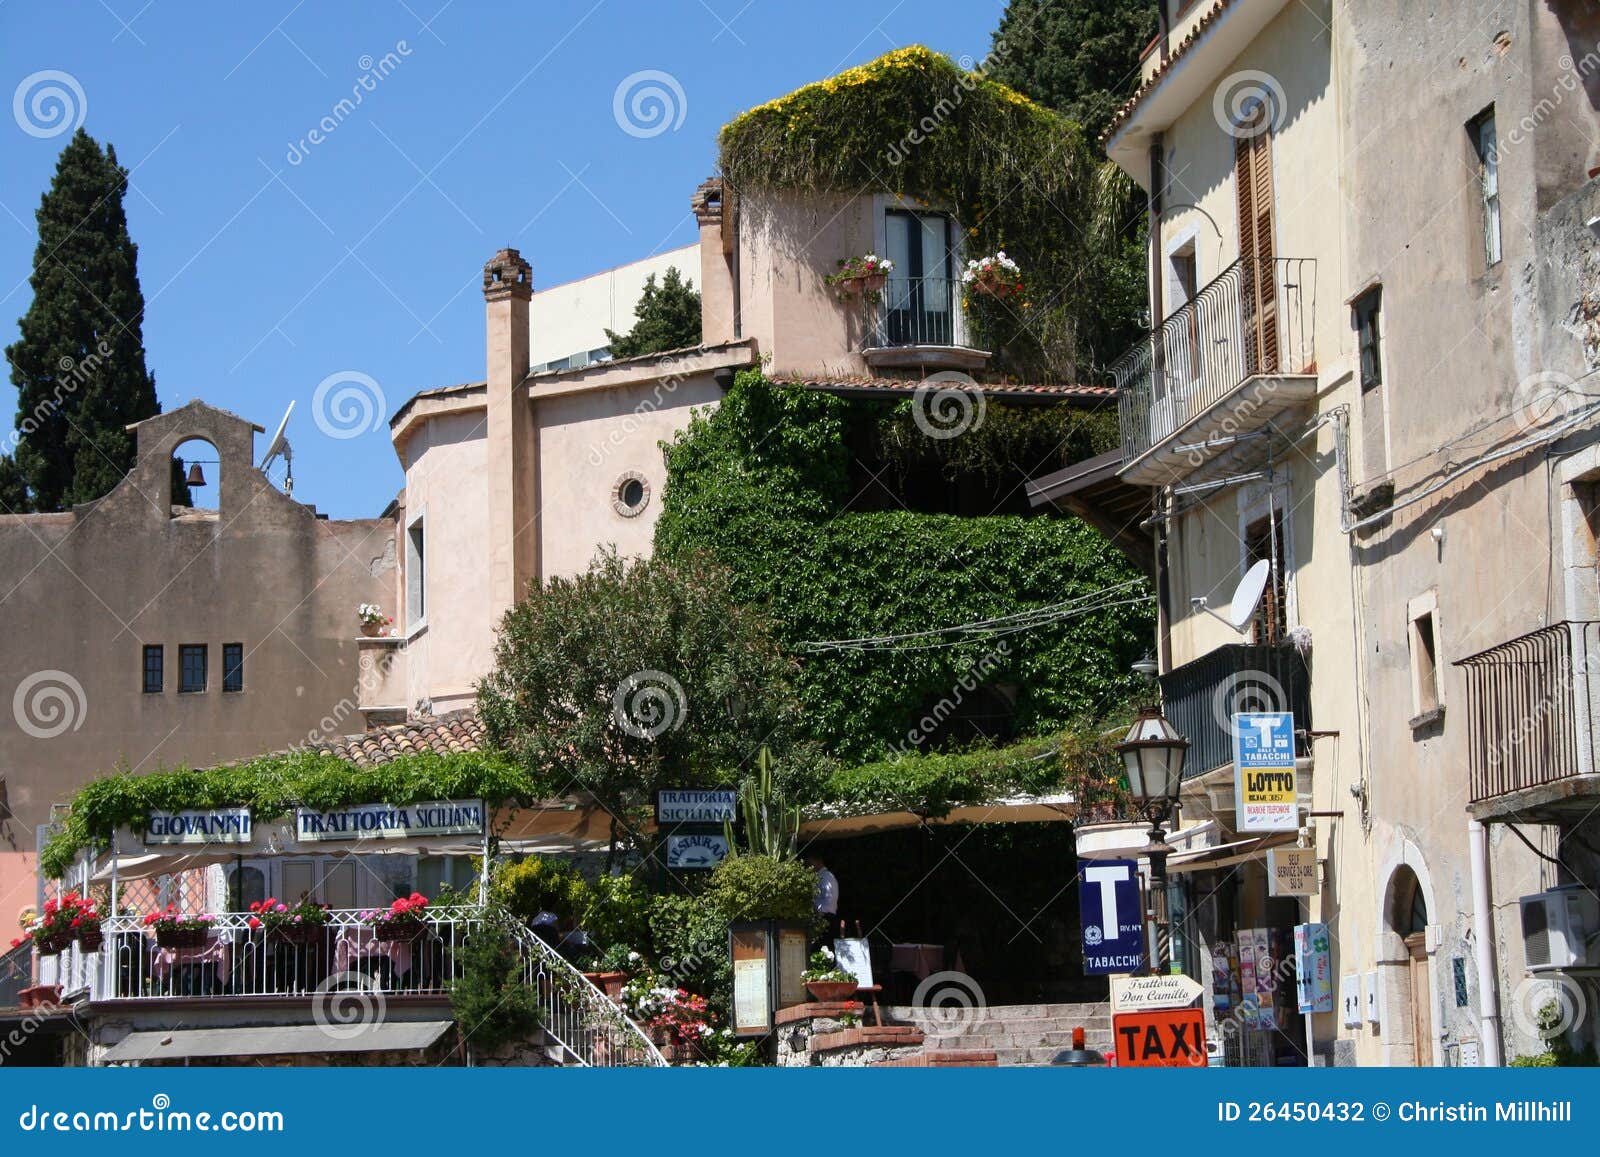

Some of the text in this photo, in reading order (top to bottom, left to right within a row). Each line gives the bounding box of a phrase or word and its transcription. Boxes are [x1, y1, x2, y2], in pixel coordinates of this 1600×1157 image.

[1245, 753, 1290, 761] TABACCHI
[1247, 773, 1293, 792] LOTTO
[662, 791, 732, 804] TRATTORIA
[300, 806, 480, 833] TRATTORIA SICILIANA
[663, 808, 732, 820] SICILIANA
[150, 815, 249, 835] GIOVANNI
[1289, 855, 1300, 865] SELF
[1278, 866, 1297, 878] SERVICE
[1085, 866, 1129, 939] T
[1088, 956, 1139, 968] TABACCHI
[1128, 979, 1178, 989] Trattoria
[1120, 989, 1189, 1002] Don Camillo
[1120, 1022, 1202, 1060] TAXI
